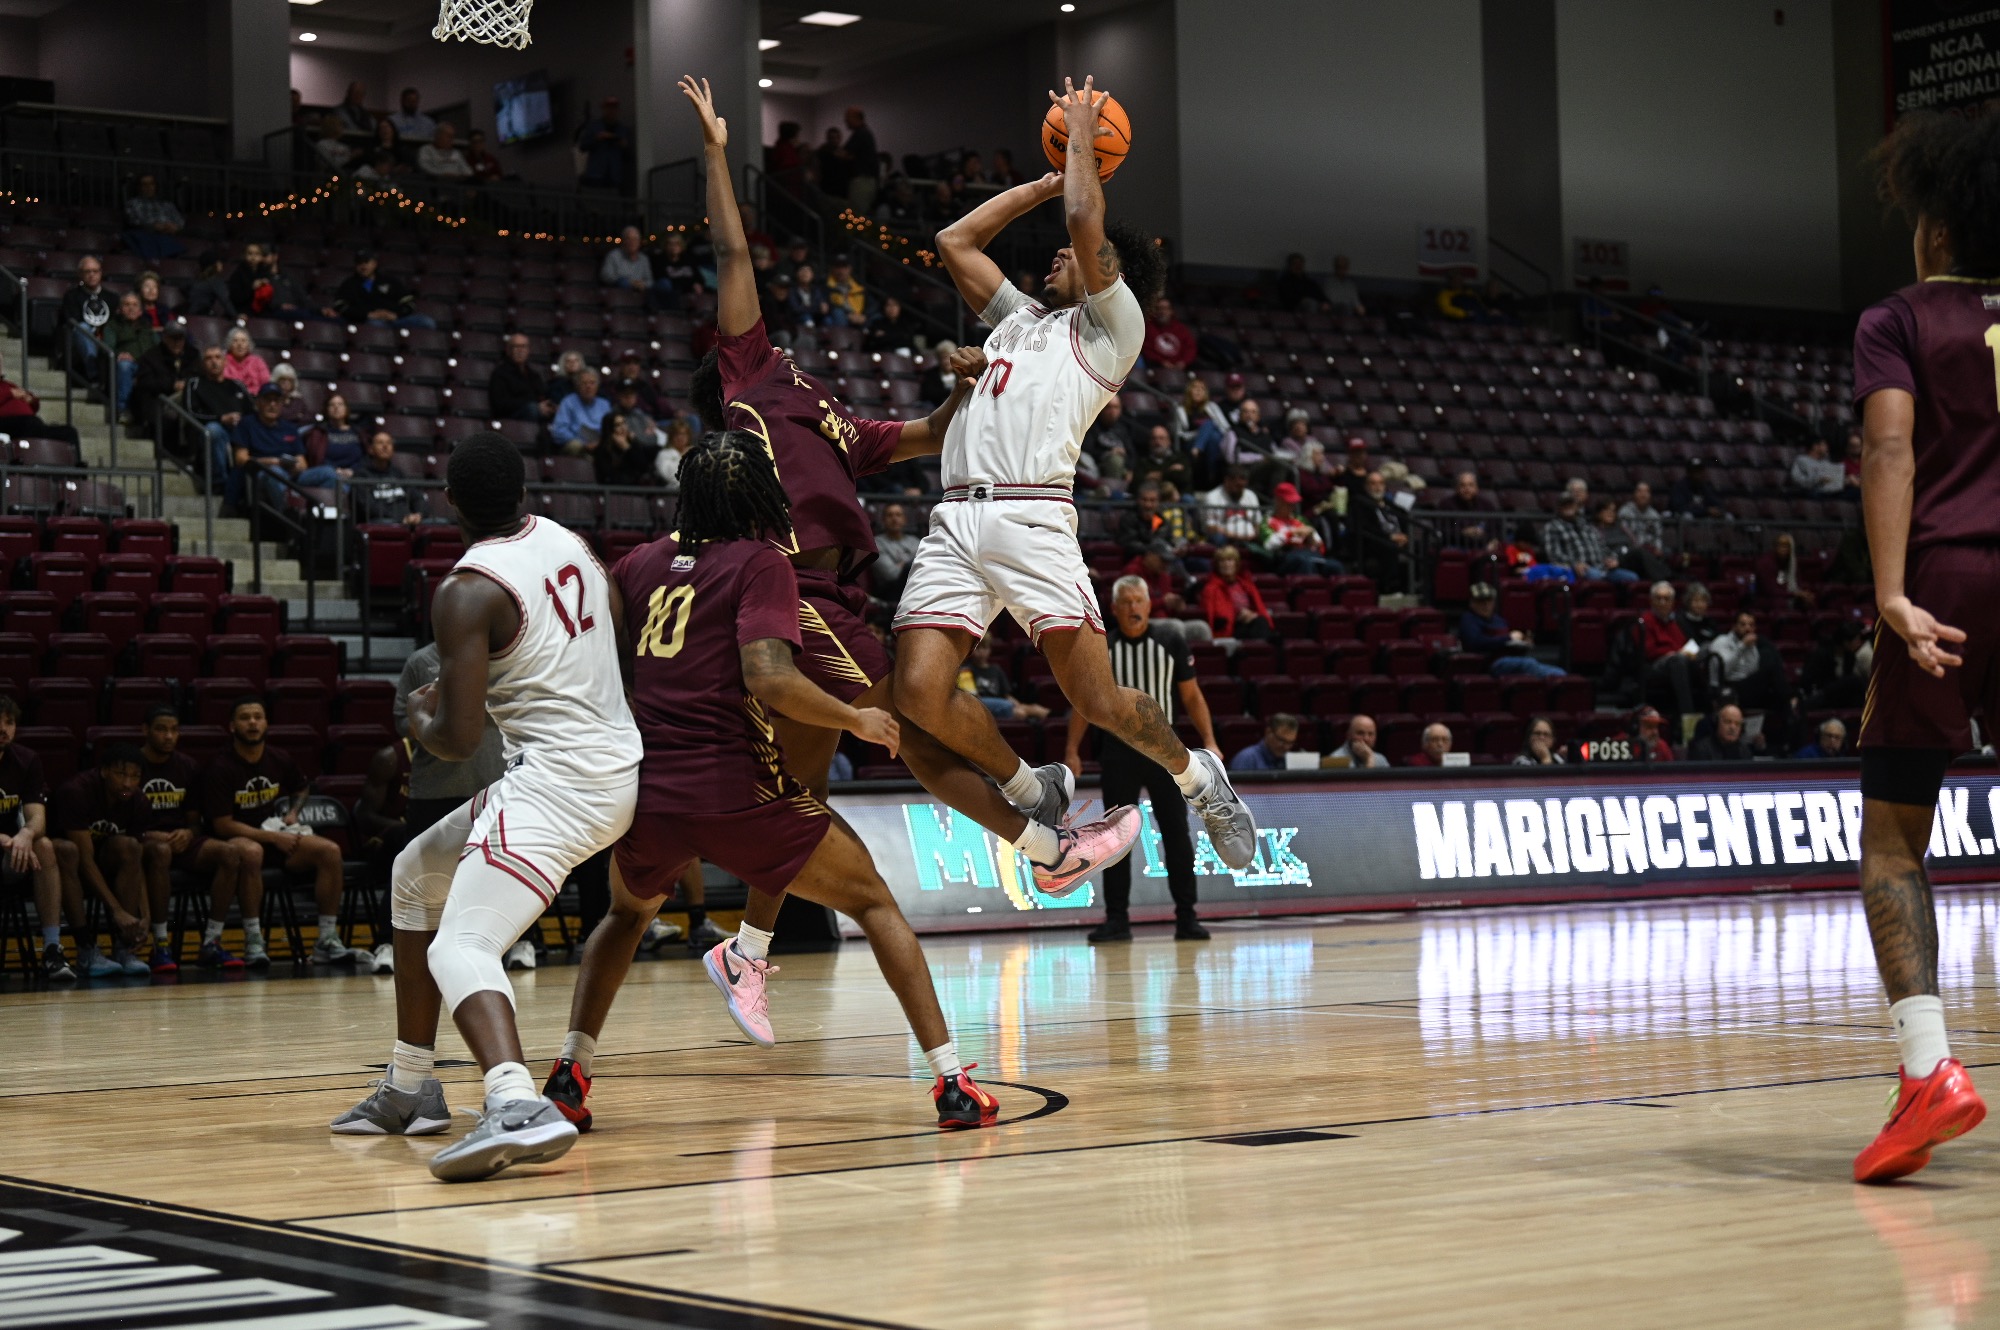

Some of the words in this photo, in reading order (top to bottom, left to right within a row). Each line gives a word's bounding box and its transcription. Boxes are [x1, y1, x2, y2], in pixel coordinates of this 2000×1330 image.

[1892, 21, 1946, 42] WOMEN'S
[1930, 32, 1984, 60] NCAA
[1425, 228, 1470, 252] 102
[1580, 243, 1624, 266] 101
[542, 561, 596, 642] 12
[636, 583, 695, 658] 10
